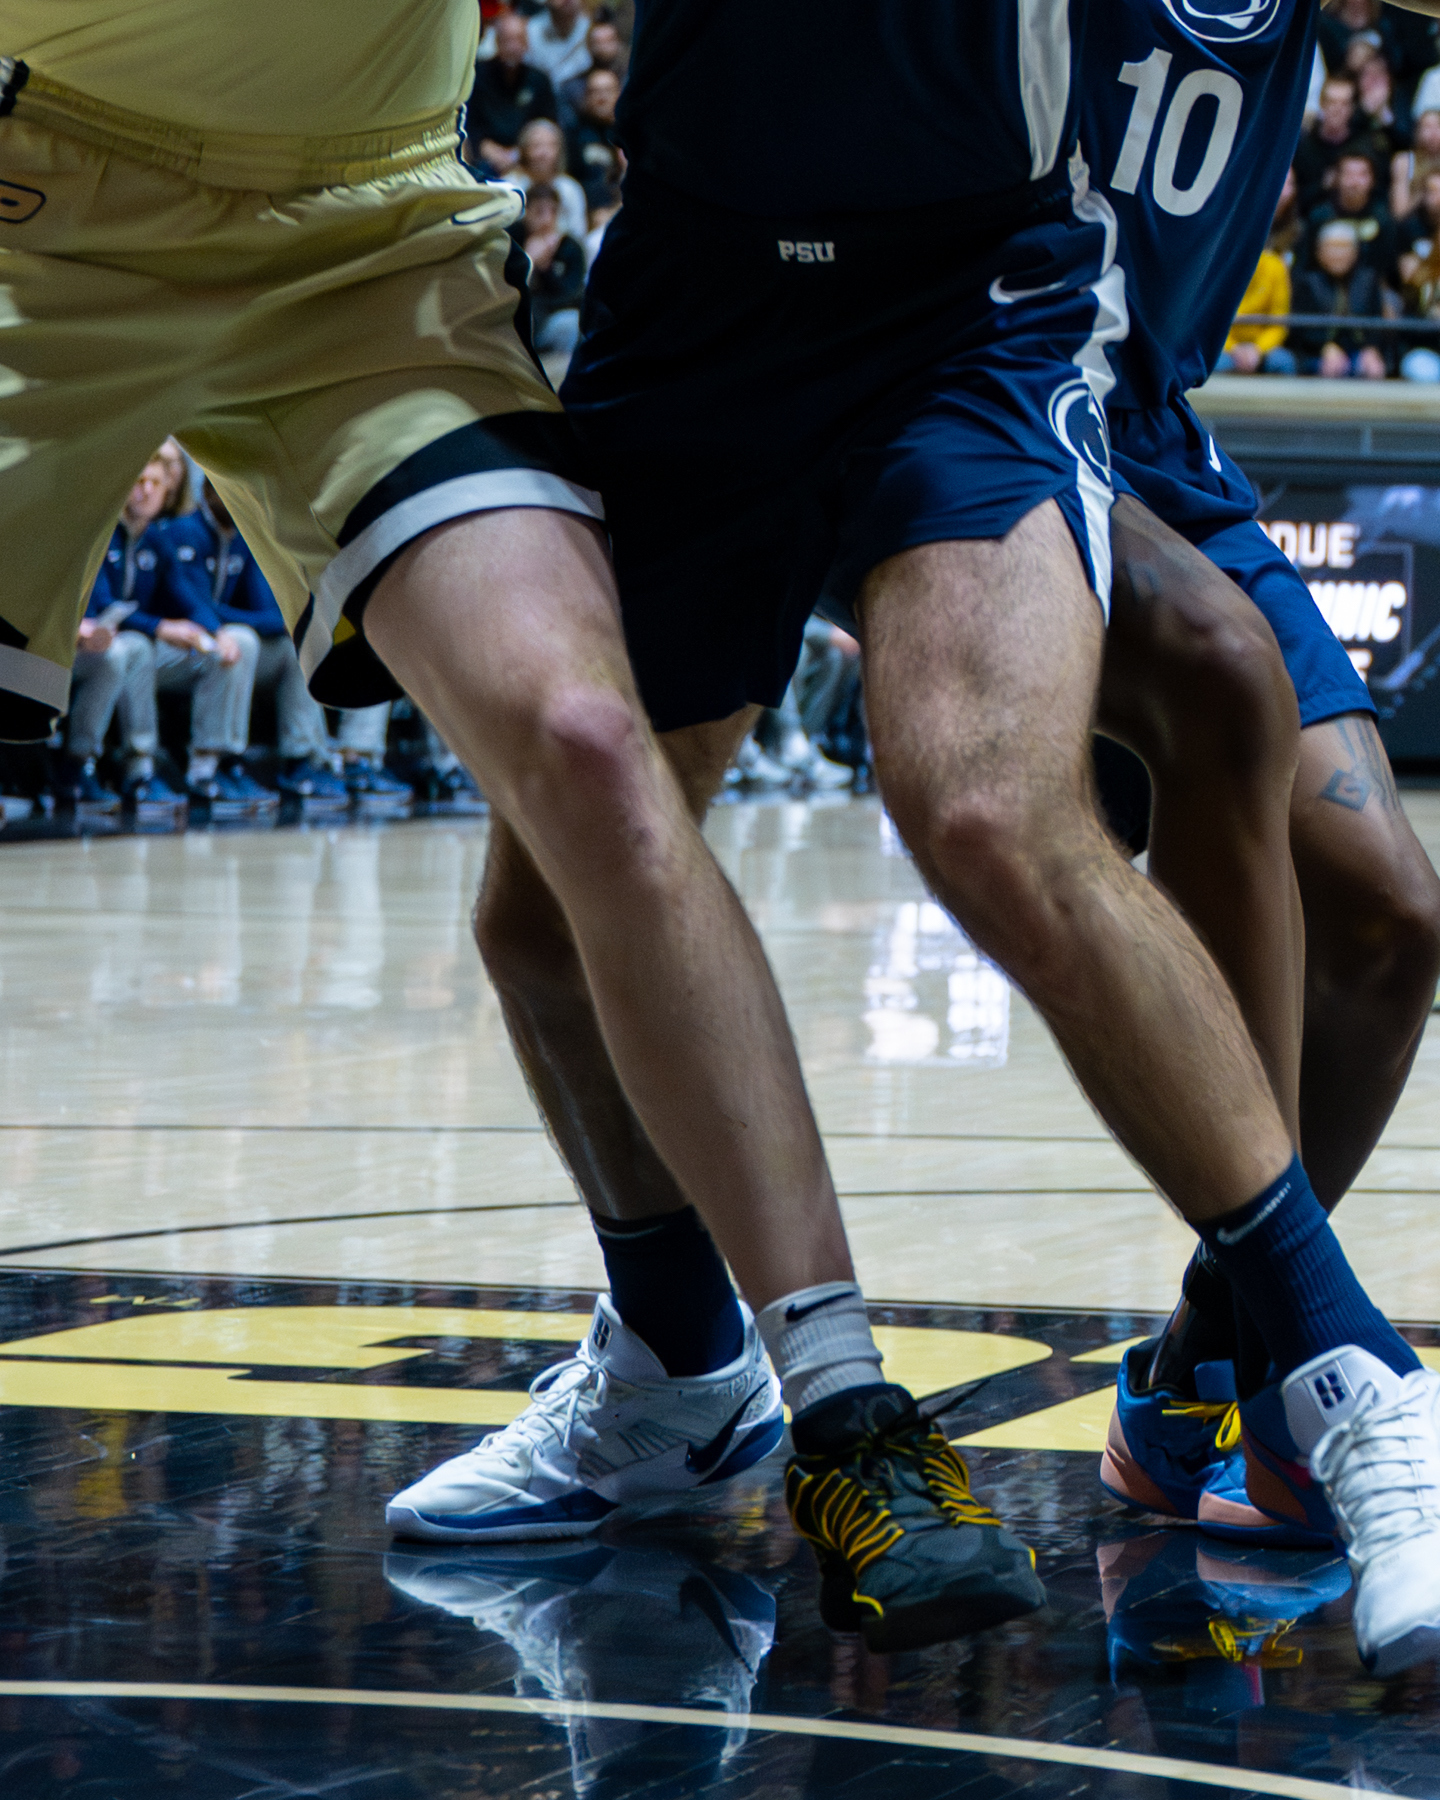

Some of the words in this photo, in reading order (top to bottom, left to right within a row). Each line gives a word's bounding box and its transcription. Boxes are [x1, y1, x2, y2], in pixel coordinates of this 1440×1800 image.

[1109, 45, 1245, 217] 10
[776, 239, 836, 263] PSU
[1258, 520, 1360, 569] DUE
